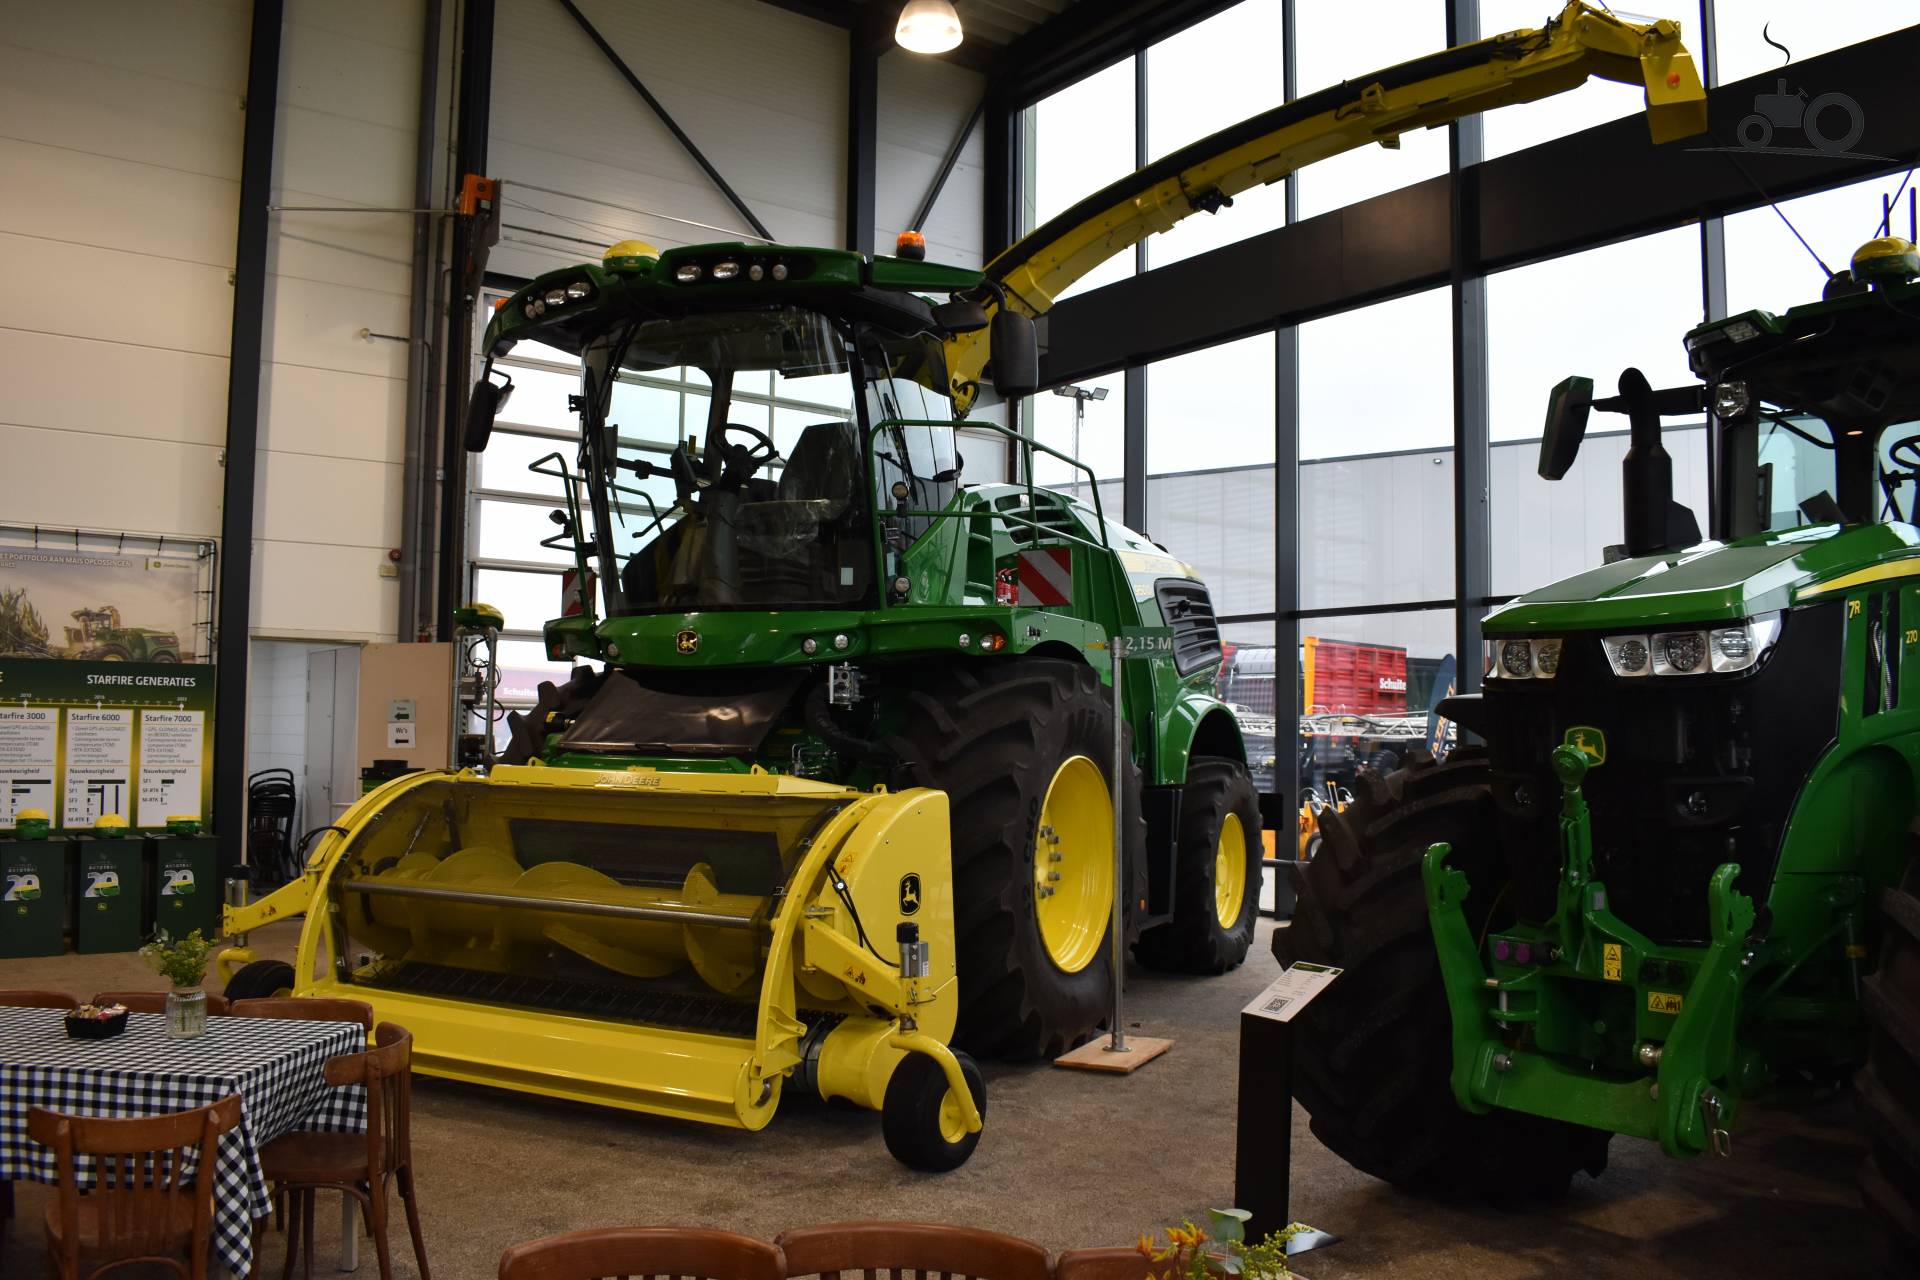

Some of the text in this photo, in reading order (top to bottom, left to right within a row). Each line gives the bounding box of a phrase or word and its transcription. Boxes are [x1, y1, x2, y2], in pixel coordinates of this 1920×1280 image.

[1848, 600, 1861, 619] 7R
[1126, 636, 1172, 651] 2,15 M
[87, 674, 196, 687] STARFIRE GENERATIES
[0, 711, 46, 720] tarfire 3000
[71, 712, 121, 721] Starfire 6000
[145, 714, 173, 722] Starfire
[0, 767, 40, 775] auwkeurigheid
[624, 774, 661, 786] DEERE
